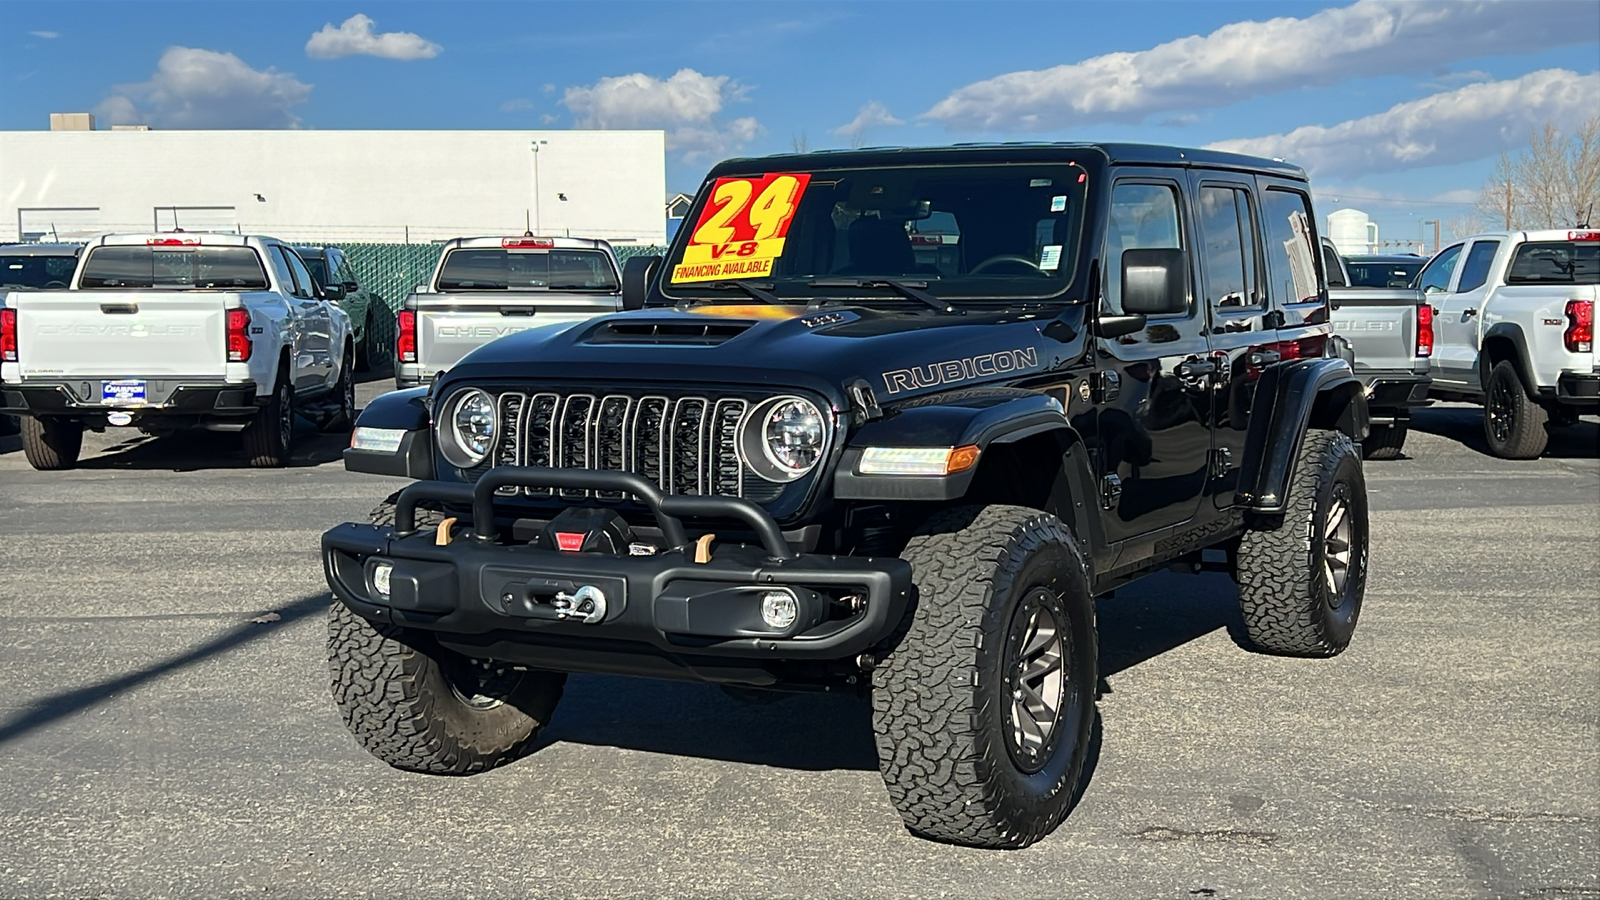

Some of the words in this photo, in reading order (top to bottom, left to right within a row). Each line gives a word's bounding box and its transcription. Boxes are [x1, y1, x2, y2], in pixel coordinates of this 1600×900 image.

[693, 175, 801, 245] 24
[711, 241, 760, 260] V-8
[675, 264, 721, 279] FINANCING
[722, 260, 769, 275] AVAILABLE
[882, 346, 1039, 394] RUBICON
